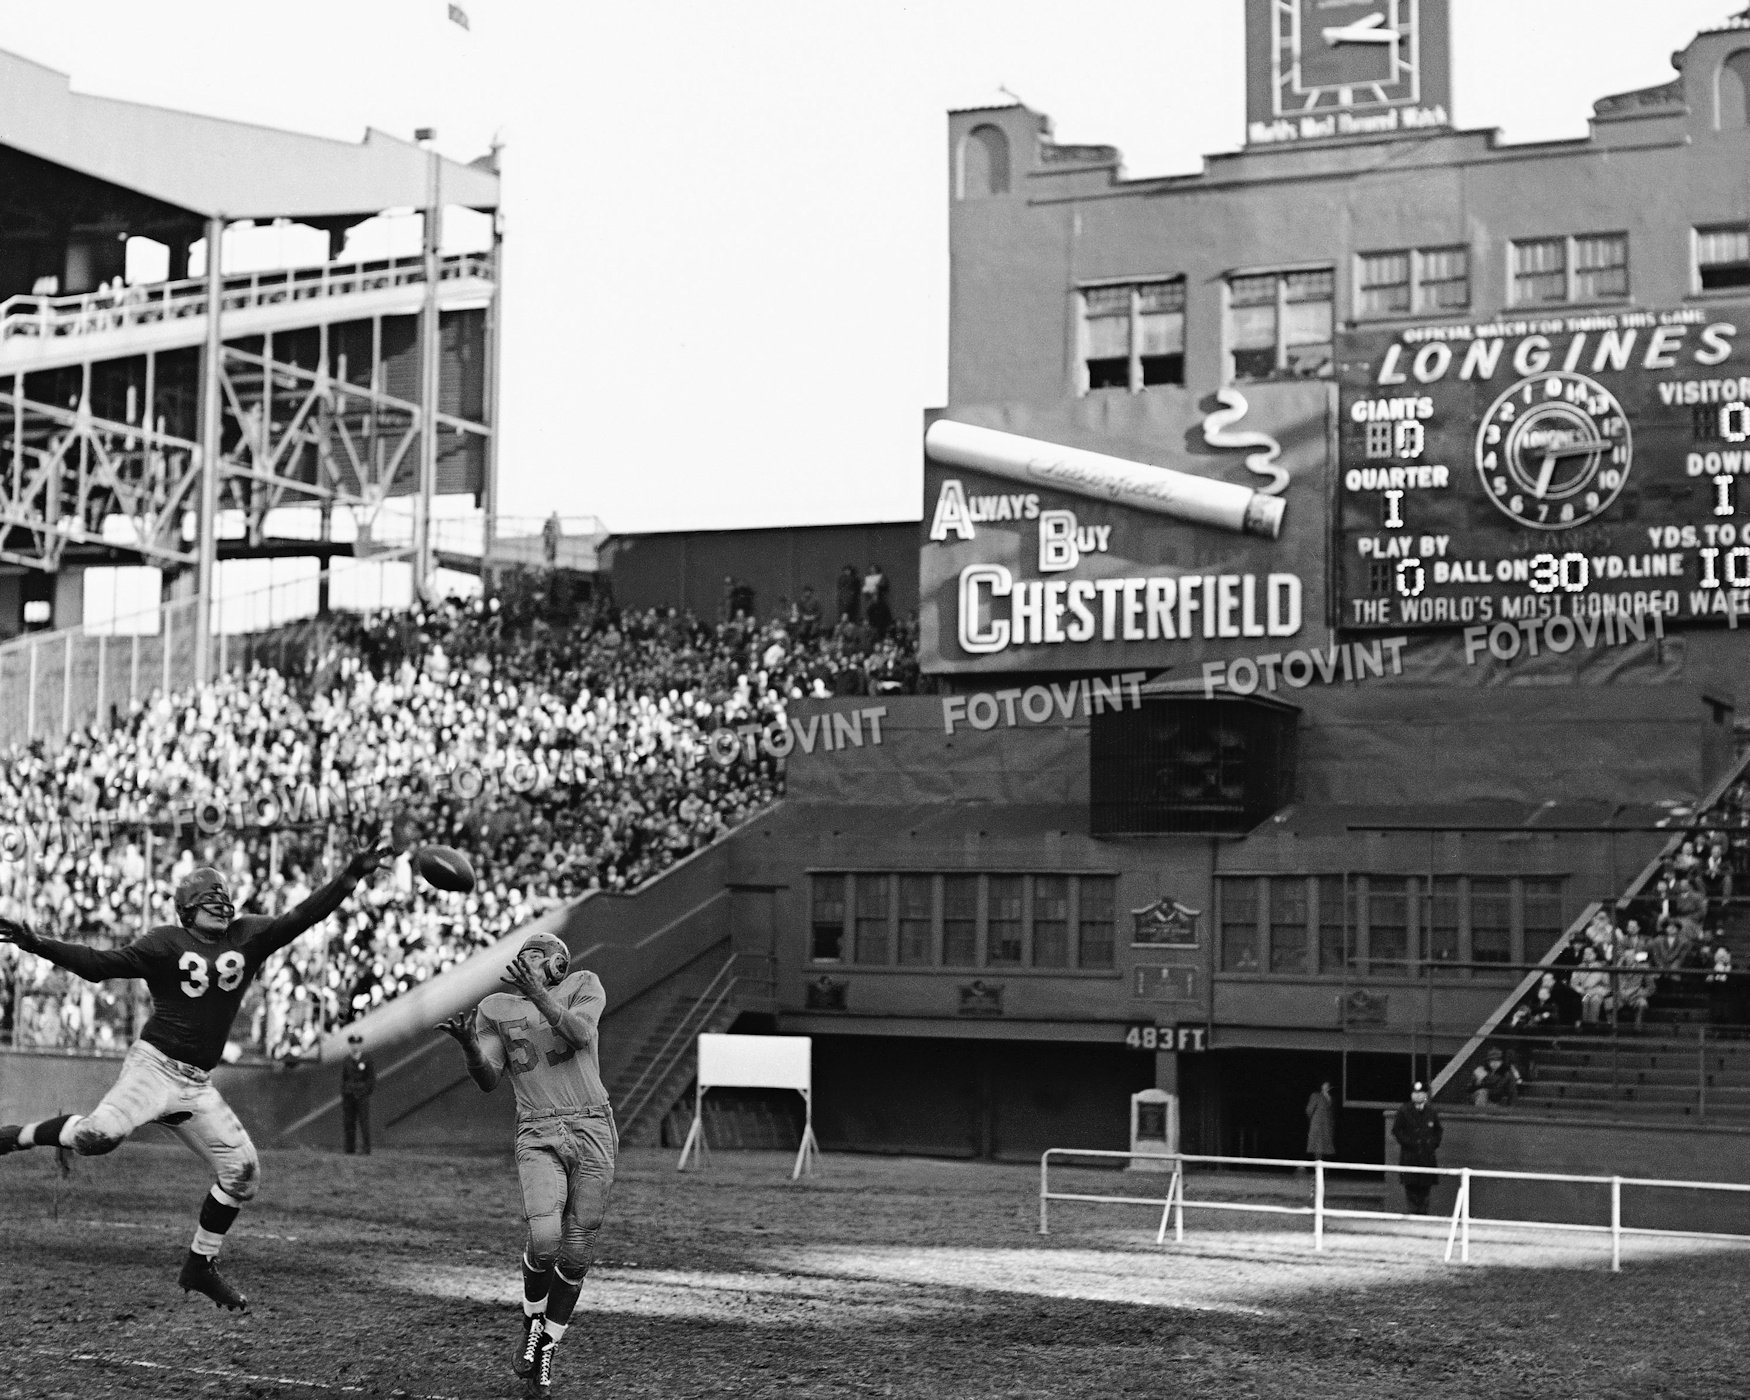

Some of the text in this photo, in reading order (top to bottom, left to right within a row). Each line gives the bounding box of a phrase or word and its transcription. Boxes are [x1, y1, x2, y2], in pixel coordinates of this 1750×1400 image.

[1378, 322, 1736, 385] LONGINES
[1351, 397, 1434, 422] GIANTS
[1346, 465, 1449, 491] QUARTER
[1358, 535, 1449, 559] PLAY BY
[1649, 525, 1701, 548] YDS.
[1704, 523, 1736, 546] TO
[1434, 560, 1494, 583] BALL
[1496, 559, 1528, 581] ON
[1529, 553, 1589, 592] 30
[958, 563, 1301, 653] CHESTERFIELD
[1353, 598, 1390, 623] THE
[1401, 596, 1493, 622] WORLD'S
[178, 950, 245, 998] 38
[1126, 1026, 1174, 1050] 483
